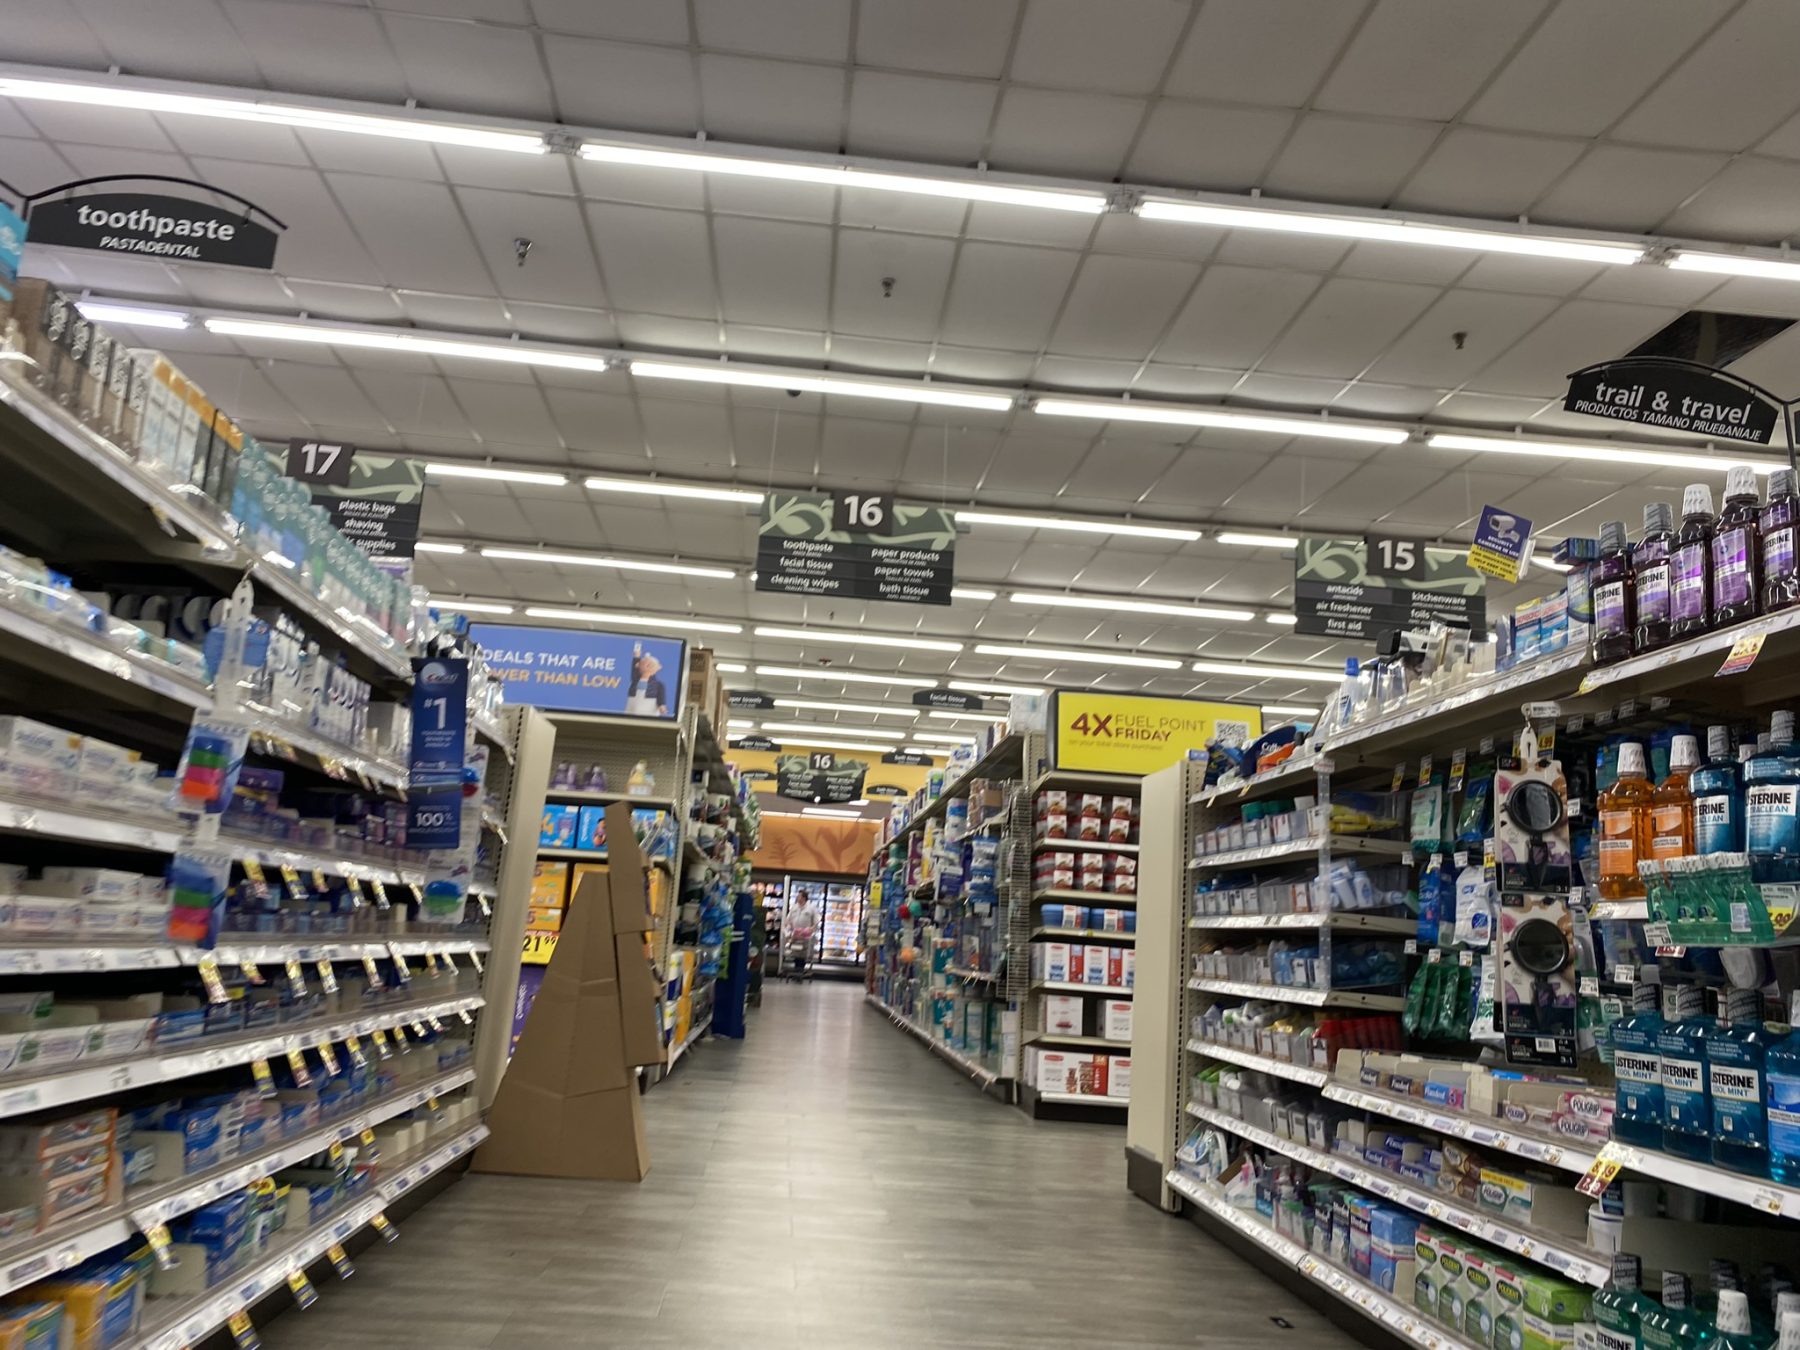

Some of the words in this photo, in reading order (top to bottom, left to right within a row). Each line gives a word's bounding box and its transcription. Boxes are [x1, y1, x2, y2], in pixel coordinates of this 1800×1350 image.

[77, 204, 235, 240] toothpaste
[99, 236, 202, 258] PASTADENTAL
[1595, 382, 1644, 407] trail
[1651, 390, 1669, 411] &
[1681, 396, 1751, 425] travel
[1575, 400, 1638, 420] PRODUCTOS
[1692, 419, 1762, 441] PRUEBANIAJE
[301, 443, 342, 475] 17
[338, 500, 371, 511] plastic
[372, 502, 396, 514] bags
[844, 495, 883, 527] 16
[345, 518, 384, 532] shaving
[356, 539, 397, 550] supplies
[783, 540, 834, 552] toothpaste
[871, 548, 898, 559] paper
[900, 550, 940, 561] products
[1378, 540, 1415, 571] 15
[780, 556, 804, 568] facial
[807, 558, 833, 570] tissue
[874, 566, 901, 577] paper
[903, 568, 934, 579] towels
[771, 574, 810, 586] cleaning
[811, 577, 840, 589] wipes
[879, 583, 901, 594] bath
[903, 585, 930, 596] tissue
[1326, 585, 1364, 596] antacids
[1411, 591, 1467, 605] kitchenware
[1316, 600, 1328, 610] air
[1330, 601, 1373, 614] freshener
[1411, 609, 1430, 619] foils
[1327, 618, 1345, 629] first
[1346, 621, 1362, 631] aid
[483, 649, 534, 664] DEALS
[538, 652, 579, 668] THAT
[582, 657, 616, 670] ARE
[535, 671, 579, 686] THAN
[582, 675, 622, 688] LOW
[1070, 712, 1112, 737] 4X
[1115, 714, 1155, 728] FUEL
[1159, 717, 1206, 732] POINT
[1115, 728, 1171, 741] FRIDAY
[813, 755, 831, 769] 16
[1749, 792, 1791, 806] STERINE
[1633, 1071, 1652, 1080] MINT
[1674, 1079, 1693, 1088] MINT
[1727, 1088, 1748, 1097] MINT
[1573, 1099, 1600, 1114] POLIGRIP
